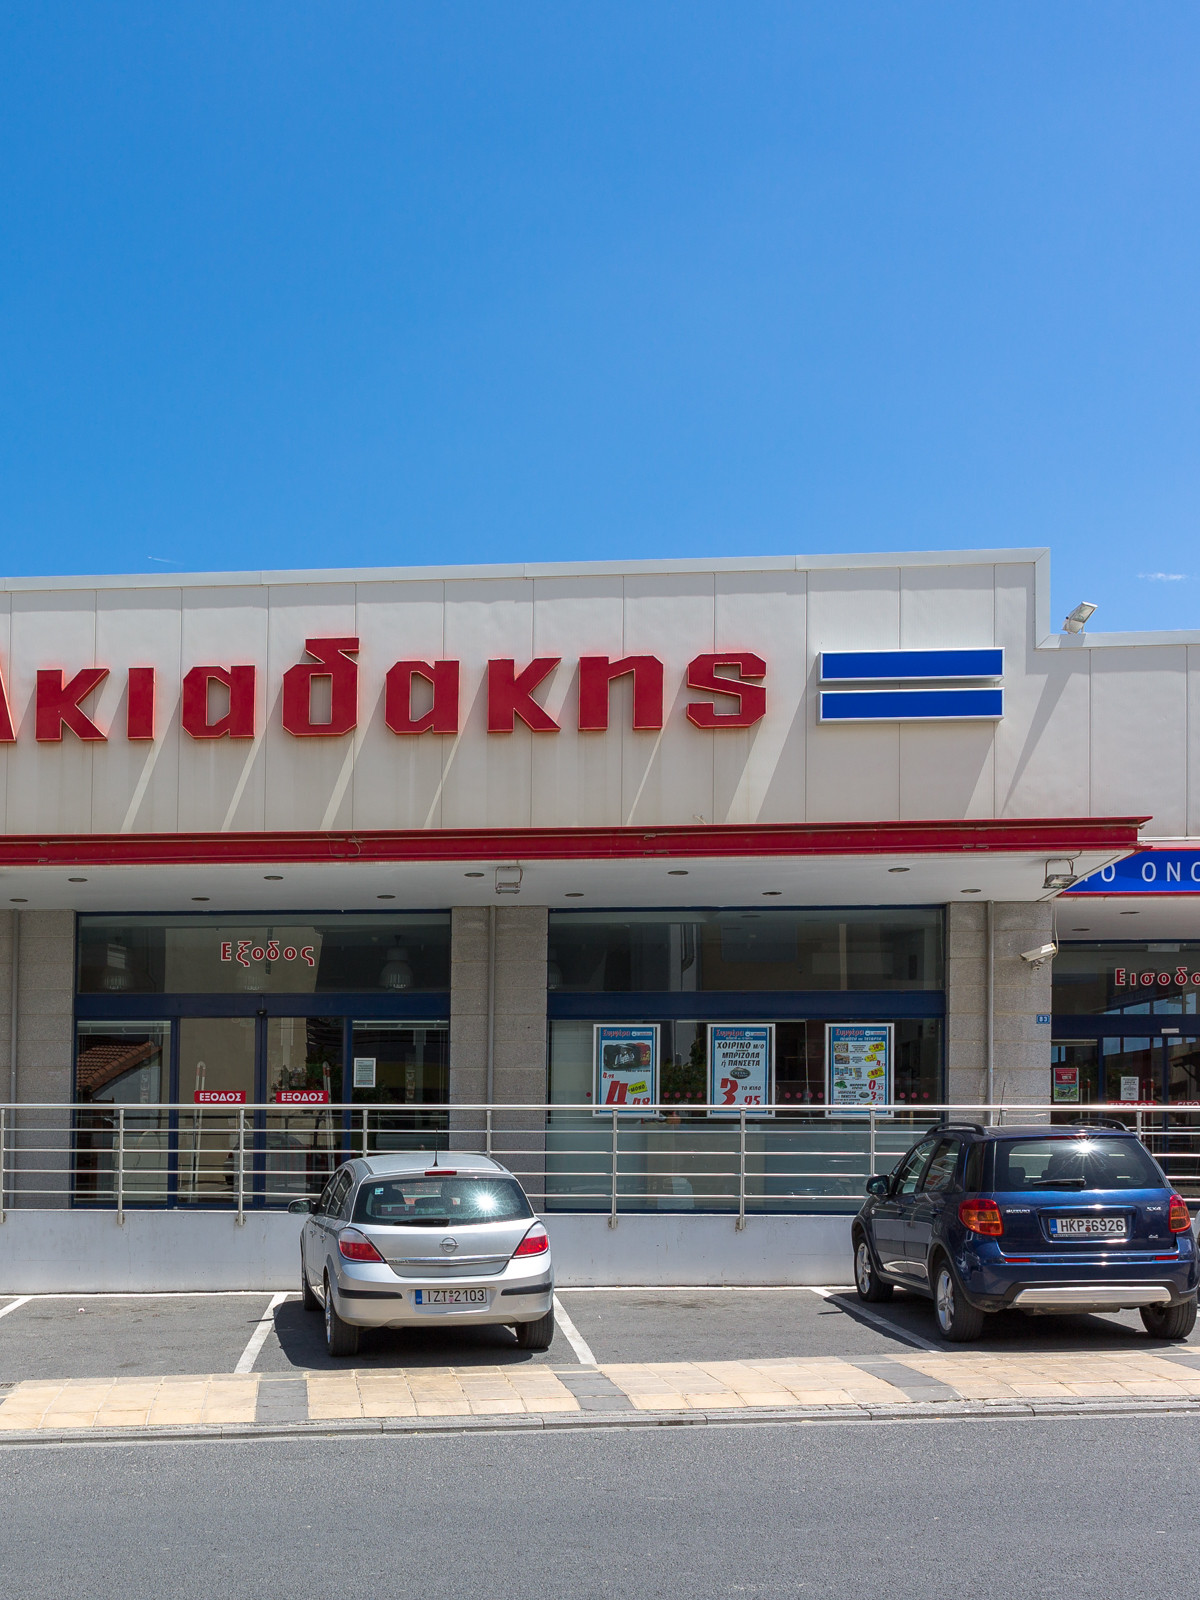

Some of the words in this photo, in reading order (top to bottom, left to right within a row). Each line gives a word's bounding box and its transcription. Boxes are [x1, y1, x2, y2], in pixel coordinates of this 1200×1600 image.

[220, 940, 315, 967] Εξοδος
[199, 1093, 242, 1101] ΕΞΟΔΟΣ
[281, 1093, 324, 1101] ΕΞΟΔΟΣ
